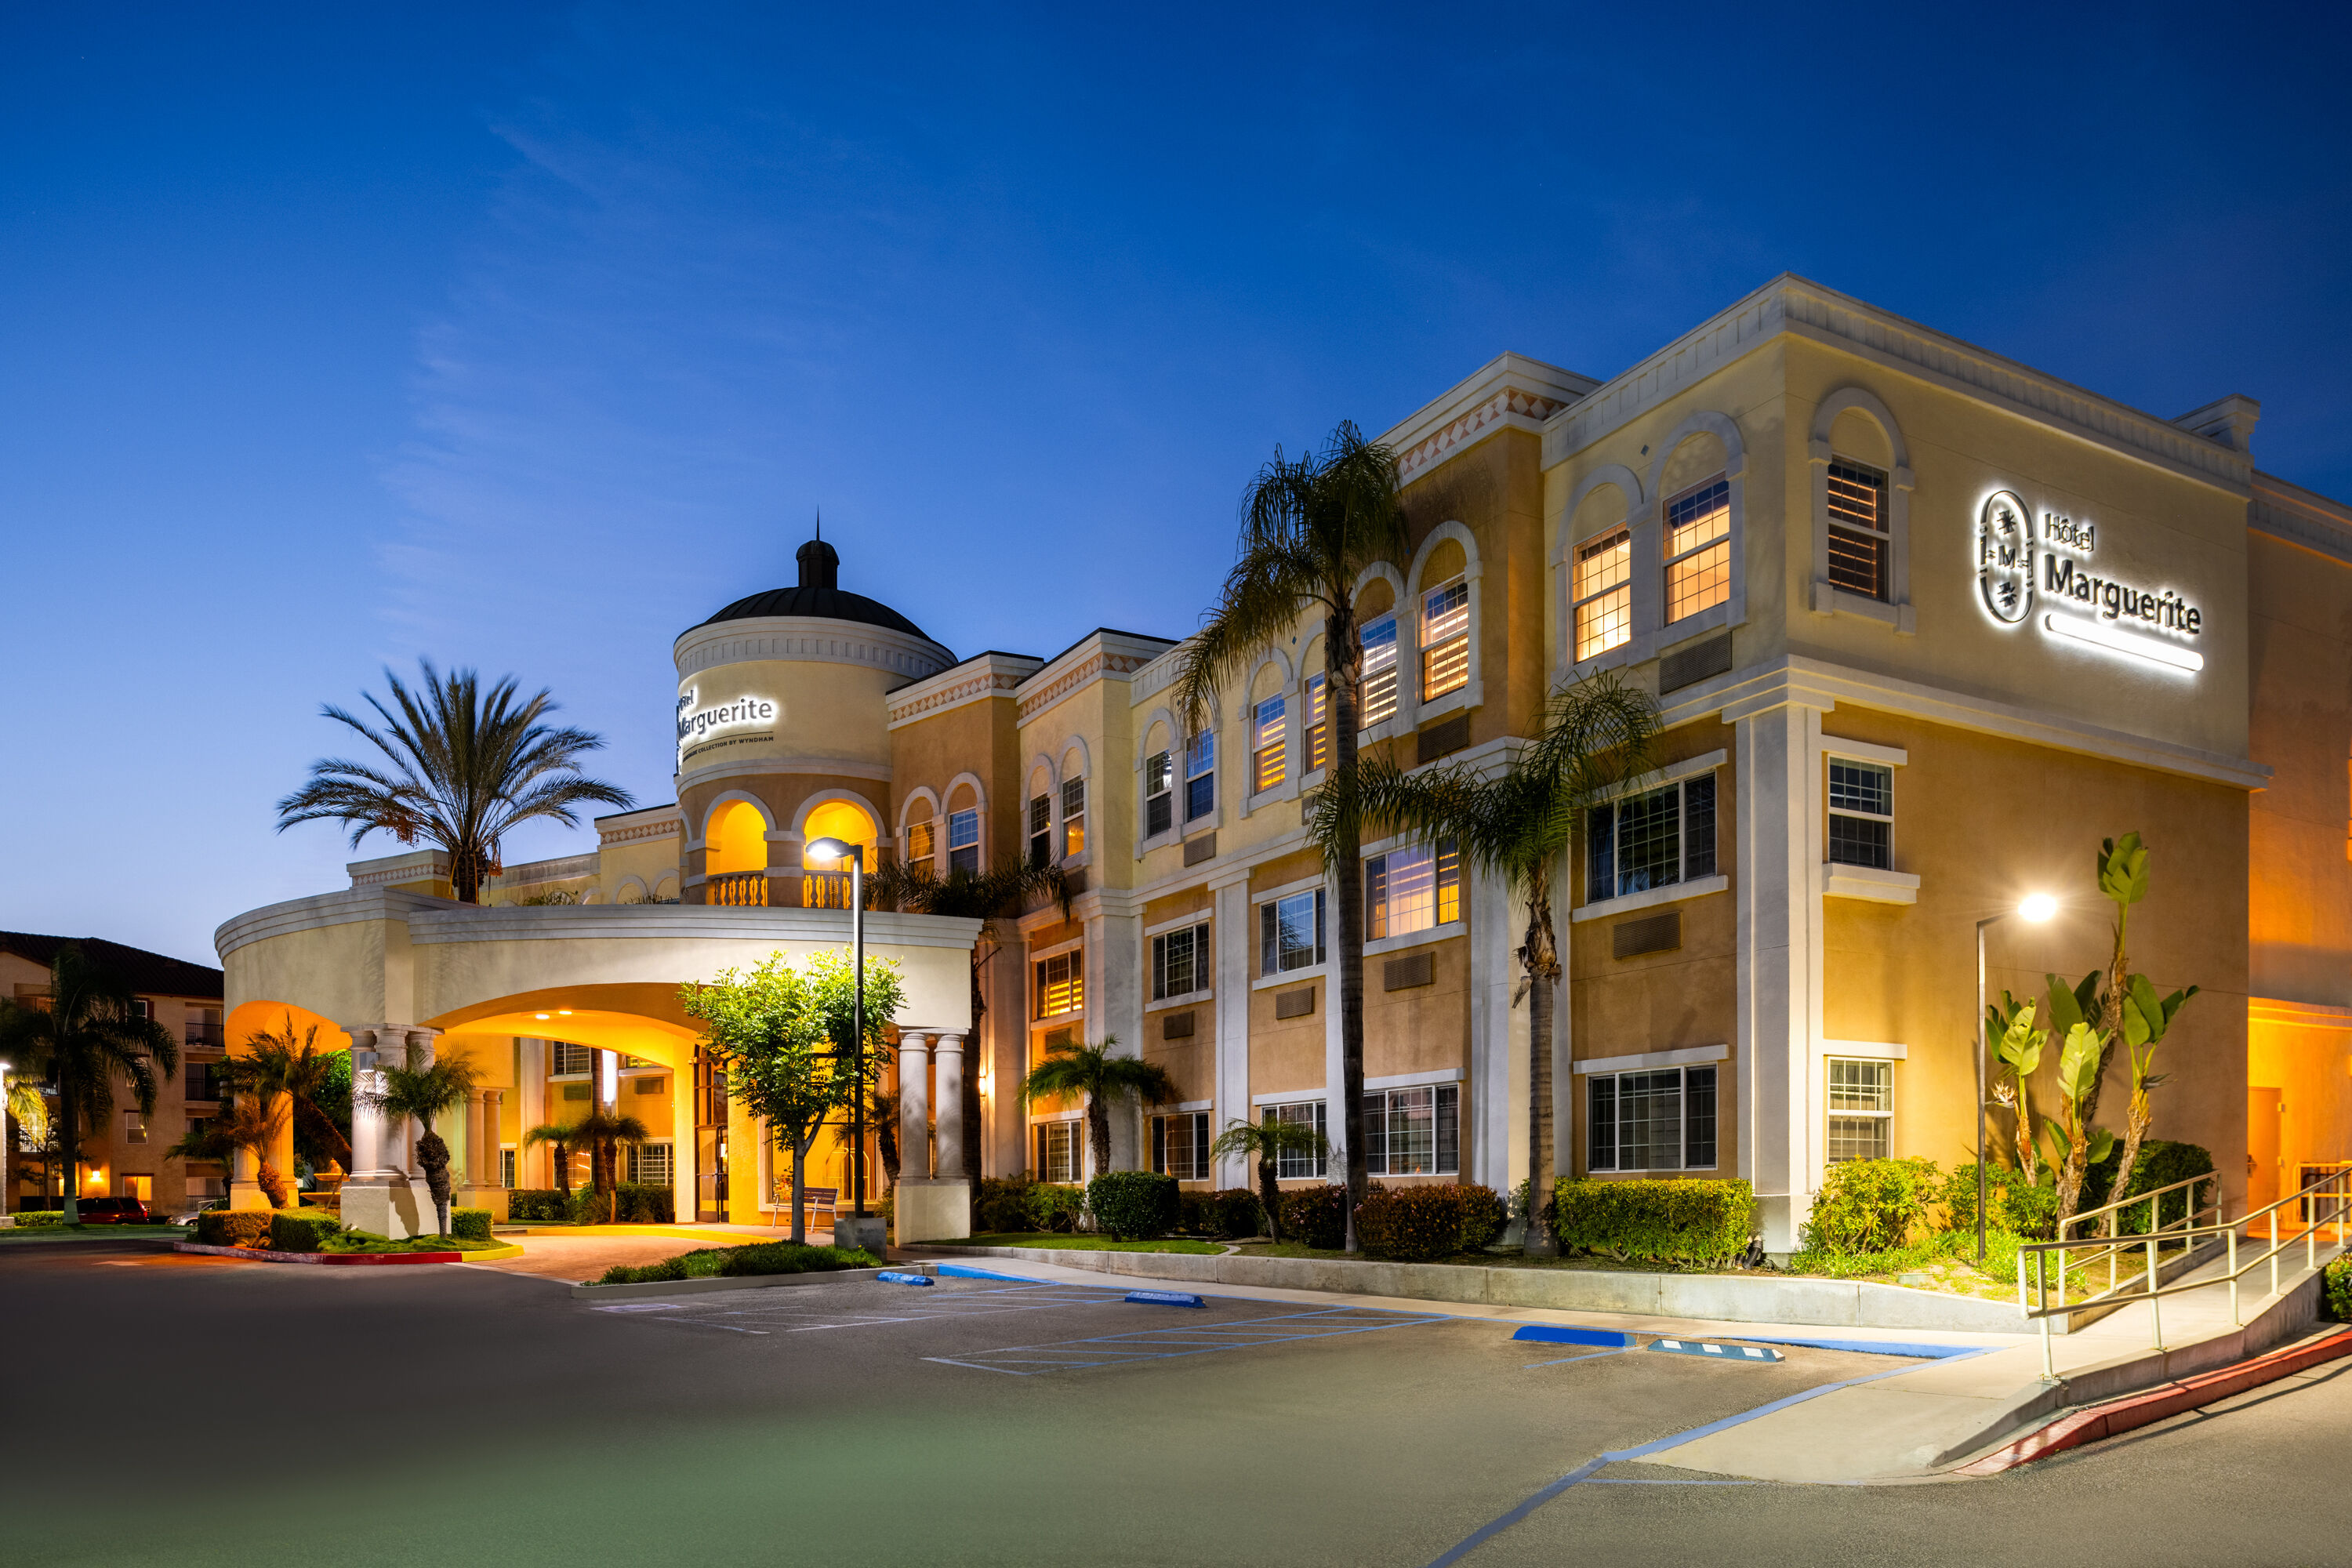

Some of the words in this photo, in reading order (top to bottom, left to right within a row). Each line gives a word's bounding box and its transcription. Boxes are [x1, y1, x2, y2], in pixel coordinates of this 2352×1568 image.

[2045, 513, 2094, 552] Hôtel
[2045, 554, 2201, 634] Marguerite
[698, 741, 728, 753] COLLECTION
